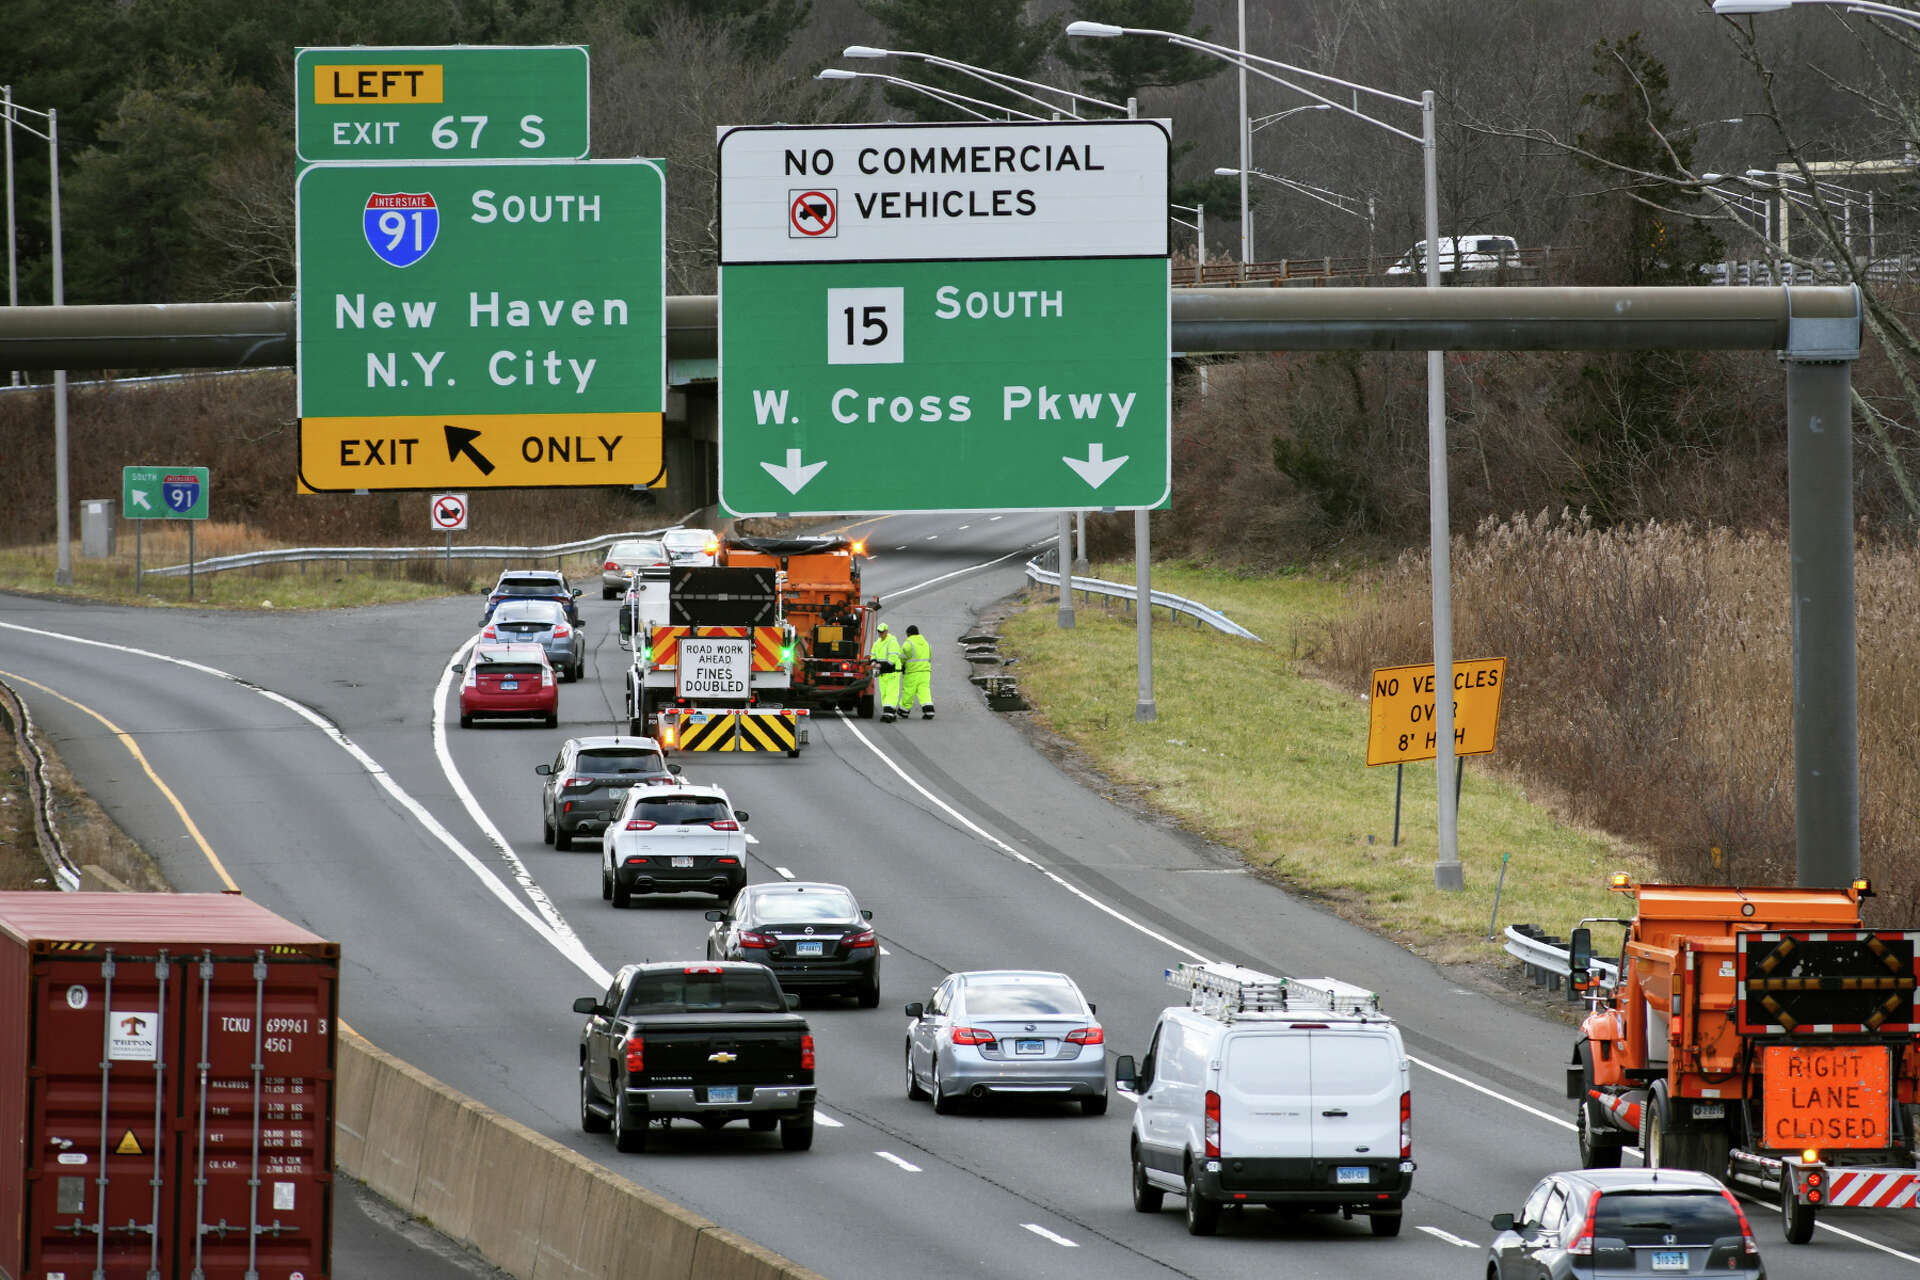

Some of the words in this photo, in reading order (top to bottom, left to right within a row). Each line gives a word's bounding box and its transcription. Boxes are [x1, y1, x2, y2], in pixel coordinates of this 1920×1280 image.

[334, 71, 424, 98] LEFT
[333, 122, 400, 145] EXIT
[431, 116, 488, 149] 67
[519, 115, 546, 149] S
[784, 149, 834, 176] NO
[858, 144, 1105, 175] COMMERCIAL
[375, 197, 427, 207] INTERSTATE
[854, 189, 1037, 219] VEHICLES
[379, 211, 422, 251] 91
[471, 190, 600, 224] SOUTH
[336, 293, 436, 329] New
[470, 292, 628, 327] Haven
[844, 306, 888, 346] 15
[935, 285, 1062, 319] SOUTH
[367, 351, 456, 387] N.Y.
[489, 350, 597, 394] City
[752, 389, 800, 425] W.
[831, 388, 972, 424] Cross
[1003, 385, 1137, 428] Pkwy
[340, 438, 419, 466] EXIT
[522, 435, 623, 463] ONLY
[132, 472, 158, 481] SOUTH
[171, 489, 192, 507] 91
[686, 644, 712, 654] ROAD
[717, 645, 744, 654] WORK
[699, 655, 732, 664] AHEAD
[696, 668, 733, 680] FINES
[1376, 678, 1399, 698] NO
[1413, 669, 1498, 694] VECLES
[686, 680, 744, 692] DOUBLED
[1425, 727, 1465, 750] HH
[221, 1016, 251, 1033] TCKU
[266, 1018, 308, 1033] 699961
[318, 1018, 328, 1035] 3
[264, 1037, 292, 1053] 45G1
[1788, 1055, 1864, 1078] RIGHT
[1791, 1086, 1861, 1109] LANE
[1776, 1118, 1876, 1139] CLOSED
